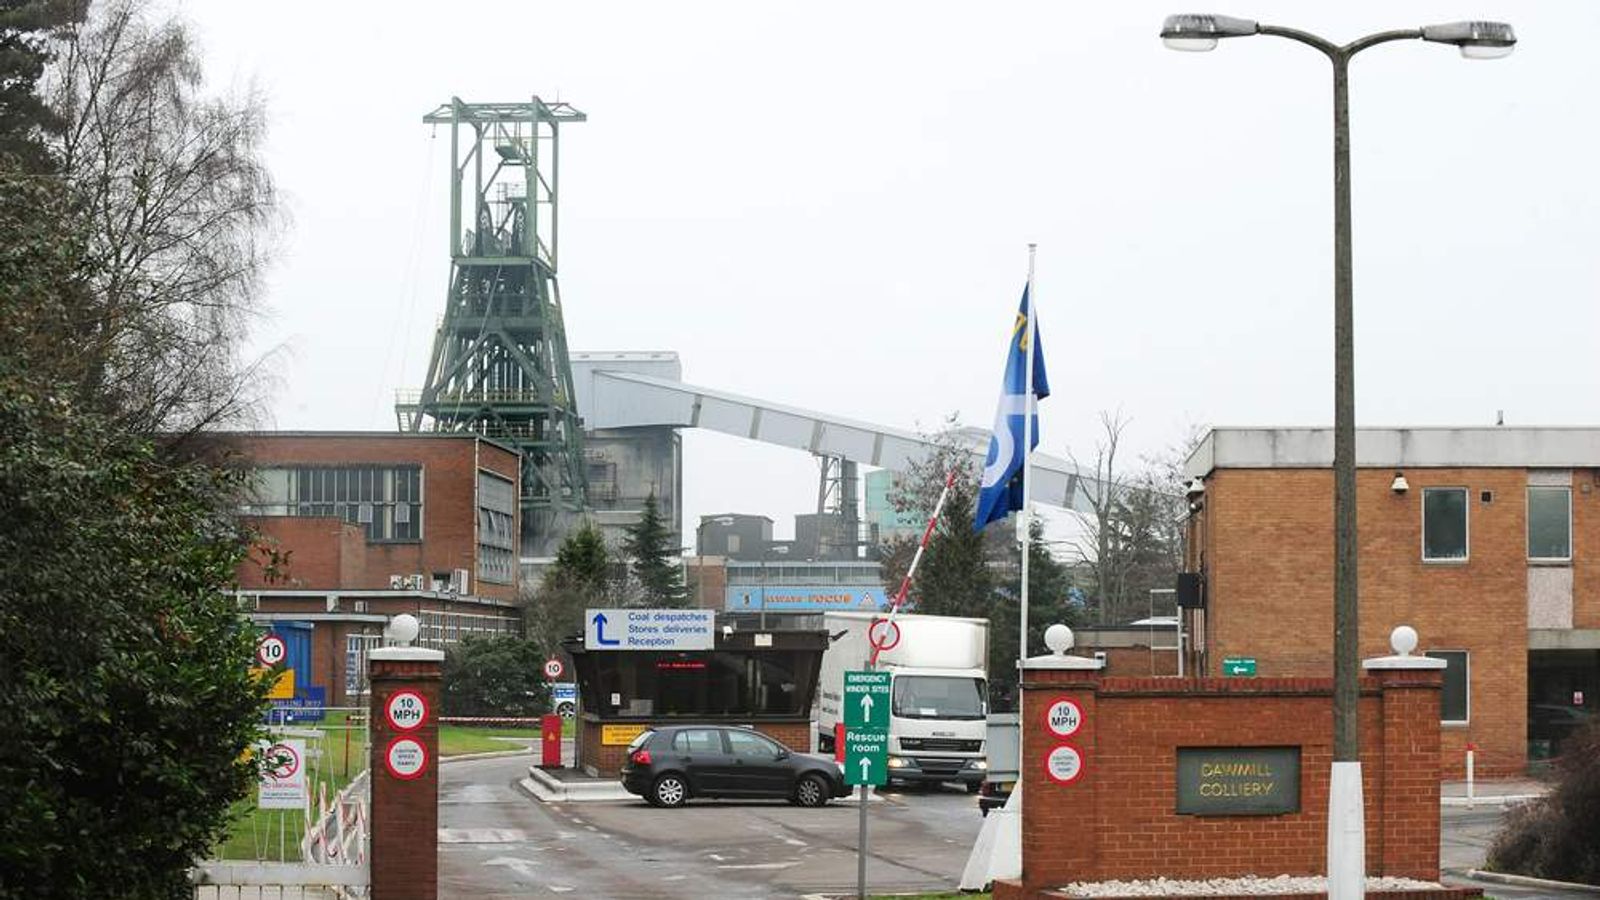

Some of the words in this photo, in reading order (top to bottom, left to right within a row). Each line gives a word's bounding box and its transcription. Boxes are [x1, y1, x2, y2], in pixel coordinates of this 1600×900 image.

[628, 612, 649, 621] Coal
[653, 612, 708, 623] despatches
[628, 624, 658, 633] Stores
[662, 624, 708, 633] deliveries
[628, 637, 675, 647] Reception
[266, 645, 281, 658] 10
[549, 664, 560, 672] 10
[847, 674, 887, 683] EMERGENCY
[401, 698, 414, 708] 10
[393, 709, 421, 720] MPH
[1058, 706, 1070, 716] 10
[1051, 717, 1077, 726] MPH
[846, 732, 887, 742] Rescue
[852, 744, 880, 752] room
[1200, 782, 1274, 797] COLLIERY
